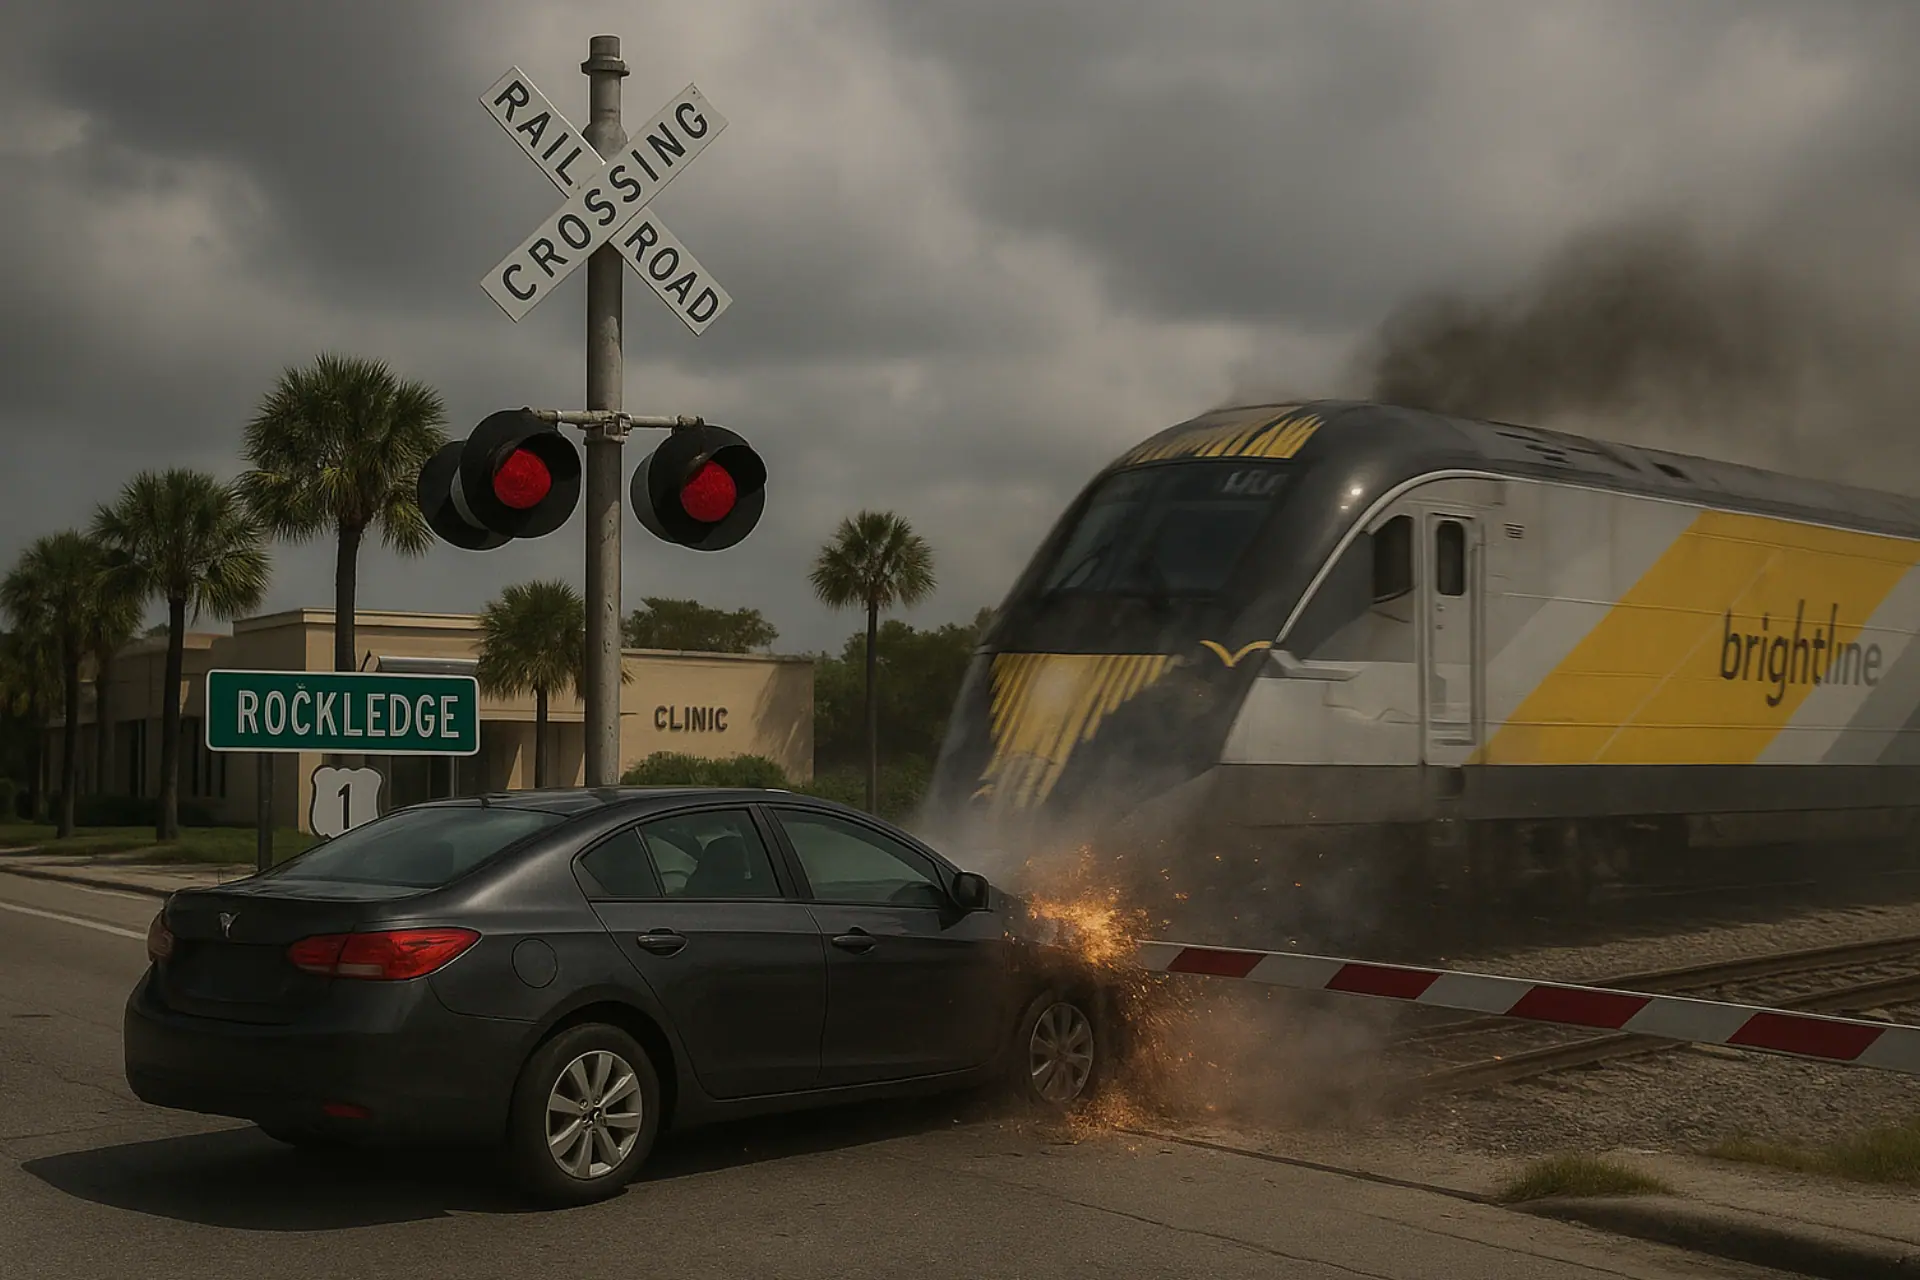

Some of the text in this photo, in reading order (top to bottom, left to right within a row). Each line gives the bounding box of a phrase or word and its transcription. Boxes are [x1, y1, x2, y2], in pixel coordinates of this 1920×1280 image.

[494, 80, 581, 186] RAIL
[502, 102, 708, 300] CROSSING
[624, 221, 718, 322] ROAD
[1720, 598, 1882, 707] brightline
[237, 690, 459, 738] ROCKLEDGE
[654, 705, 728, 732] CLINIC
[337, 783, 351, 830] 1
